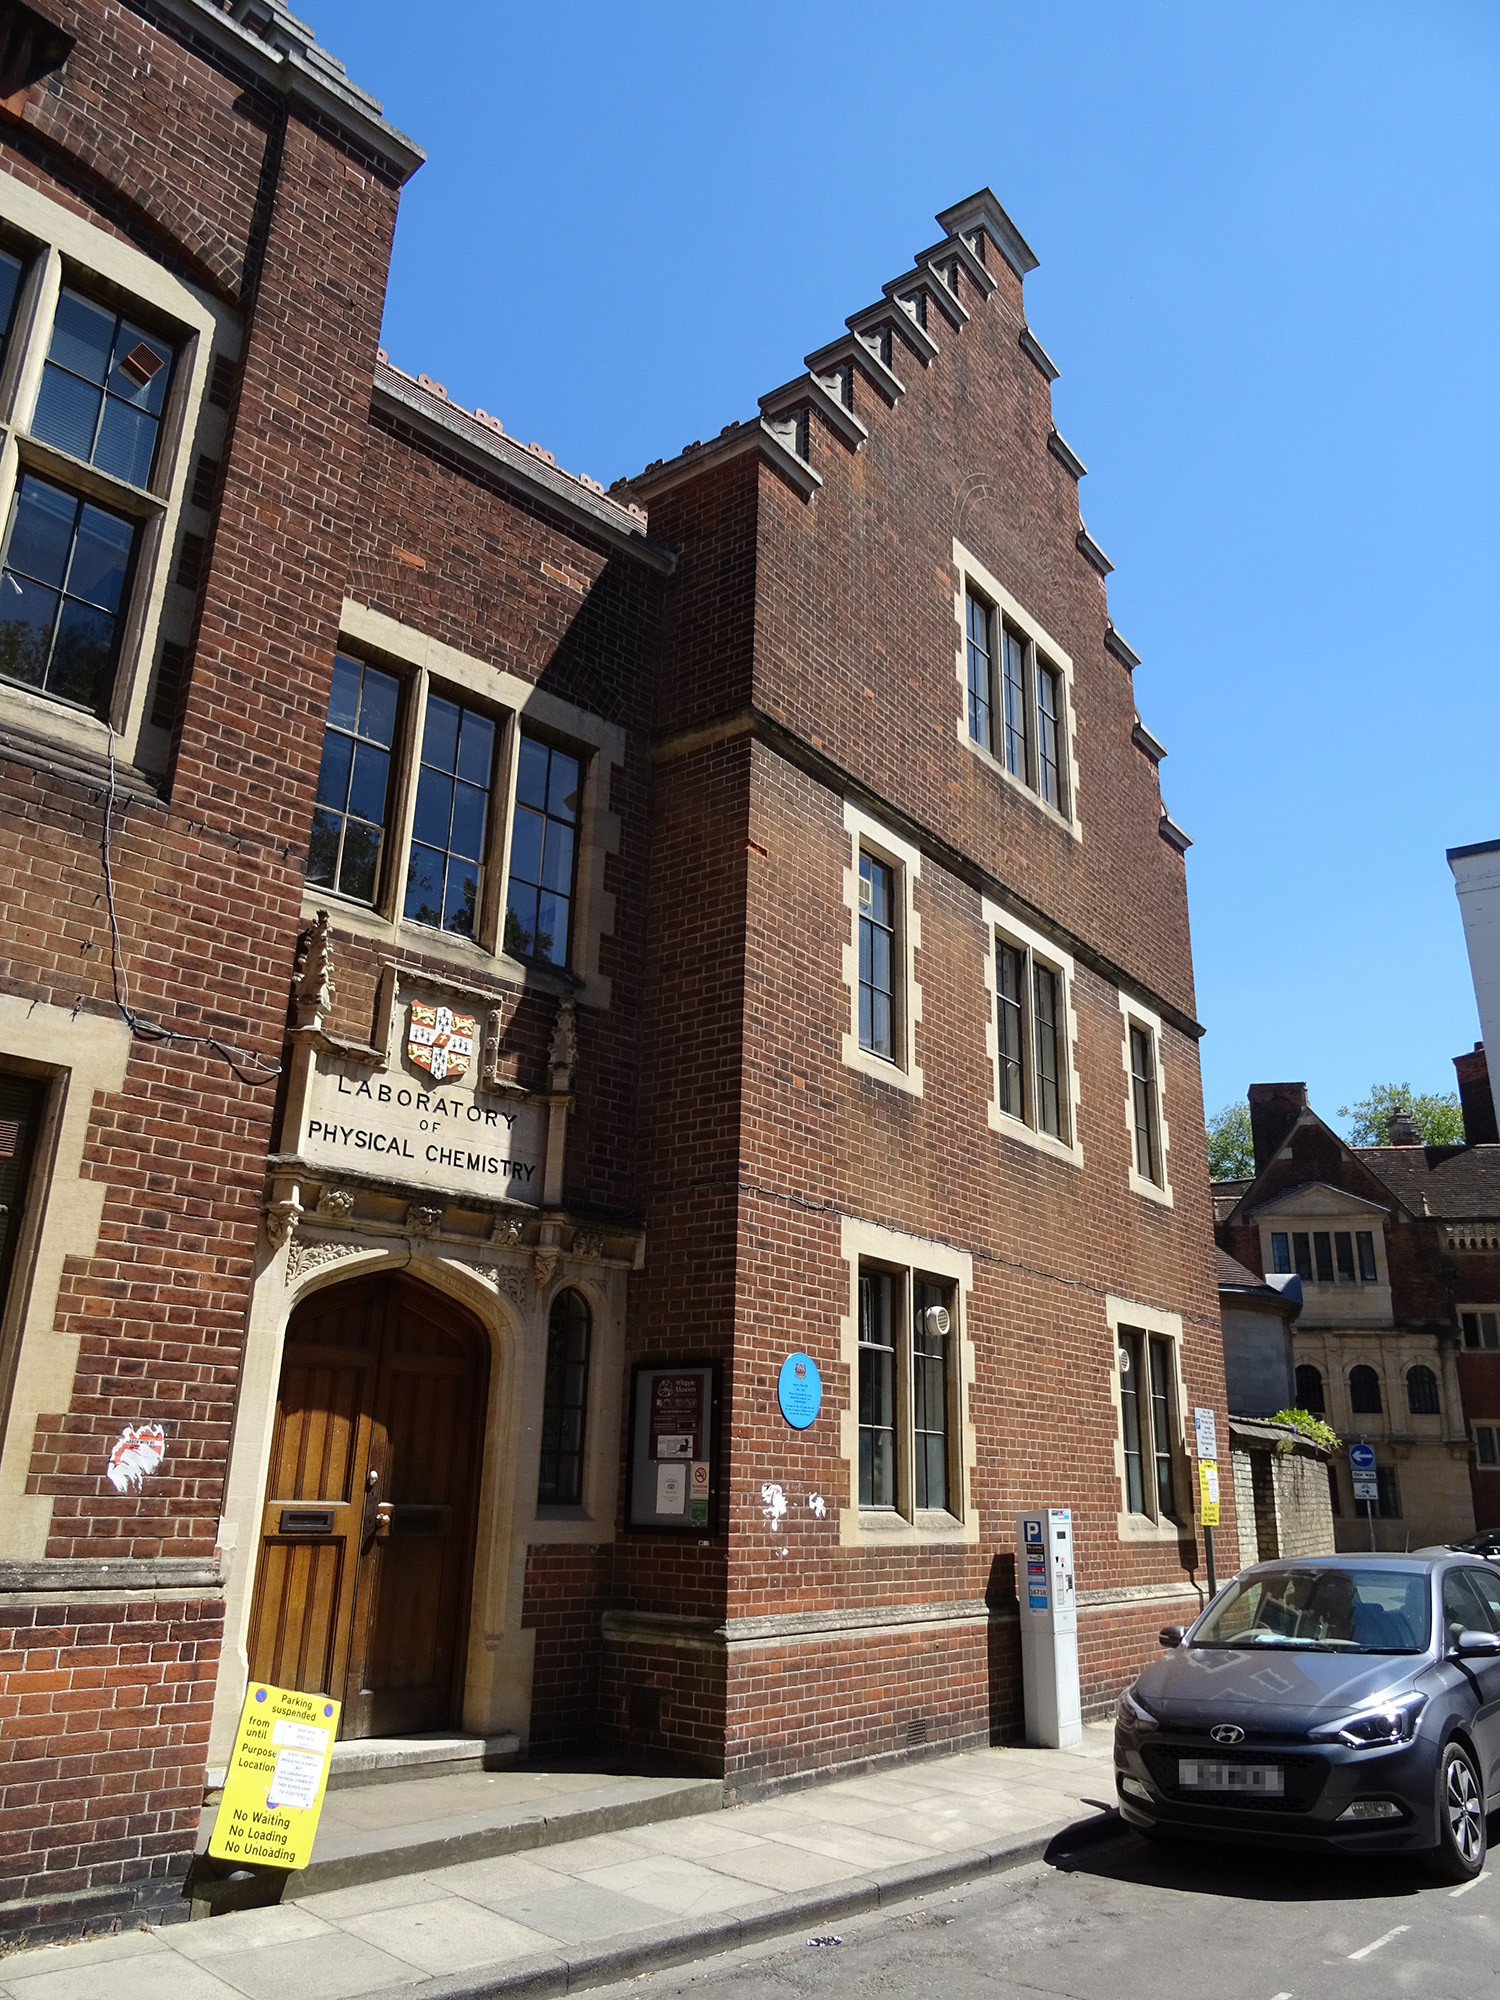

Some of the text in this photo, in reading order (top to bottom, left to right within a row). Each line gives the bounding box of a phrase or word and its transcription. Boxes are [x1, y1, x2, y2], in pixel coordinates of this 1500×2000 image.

[338, 1075, 517, 1130] LABORATORY
[419, 1120, 441, 1133] OF
[308, 1120, 536, 1182] PHYSICAL CHEMISTRY
[1026, 1522, 1039, 1541] P
[281, 1694, 313, 1710] Parking
[249, 1716, 270, 1728] from
[272, 1705, 316, 1722] suspended
[246, 1727, 267, 1740] until
[242, 1743, 277, 1759] Purpose
[238, 1758, 276, 1773] Location
[233, 1809, 290, 1830] No Waiting
[229, 1825, 288, 1846] No Loading
[225, 1841, 296, 1863] No Unloading
